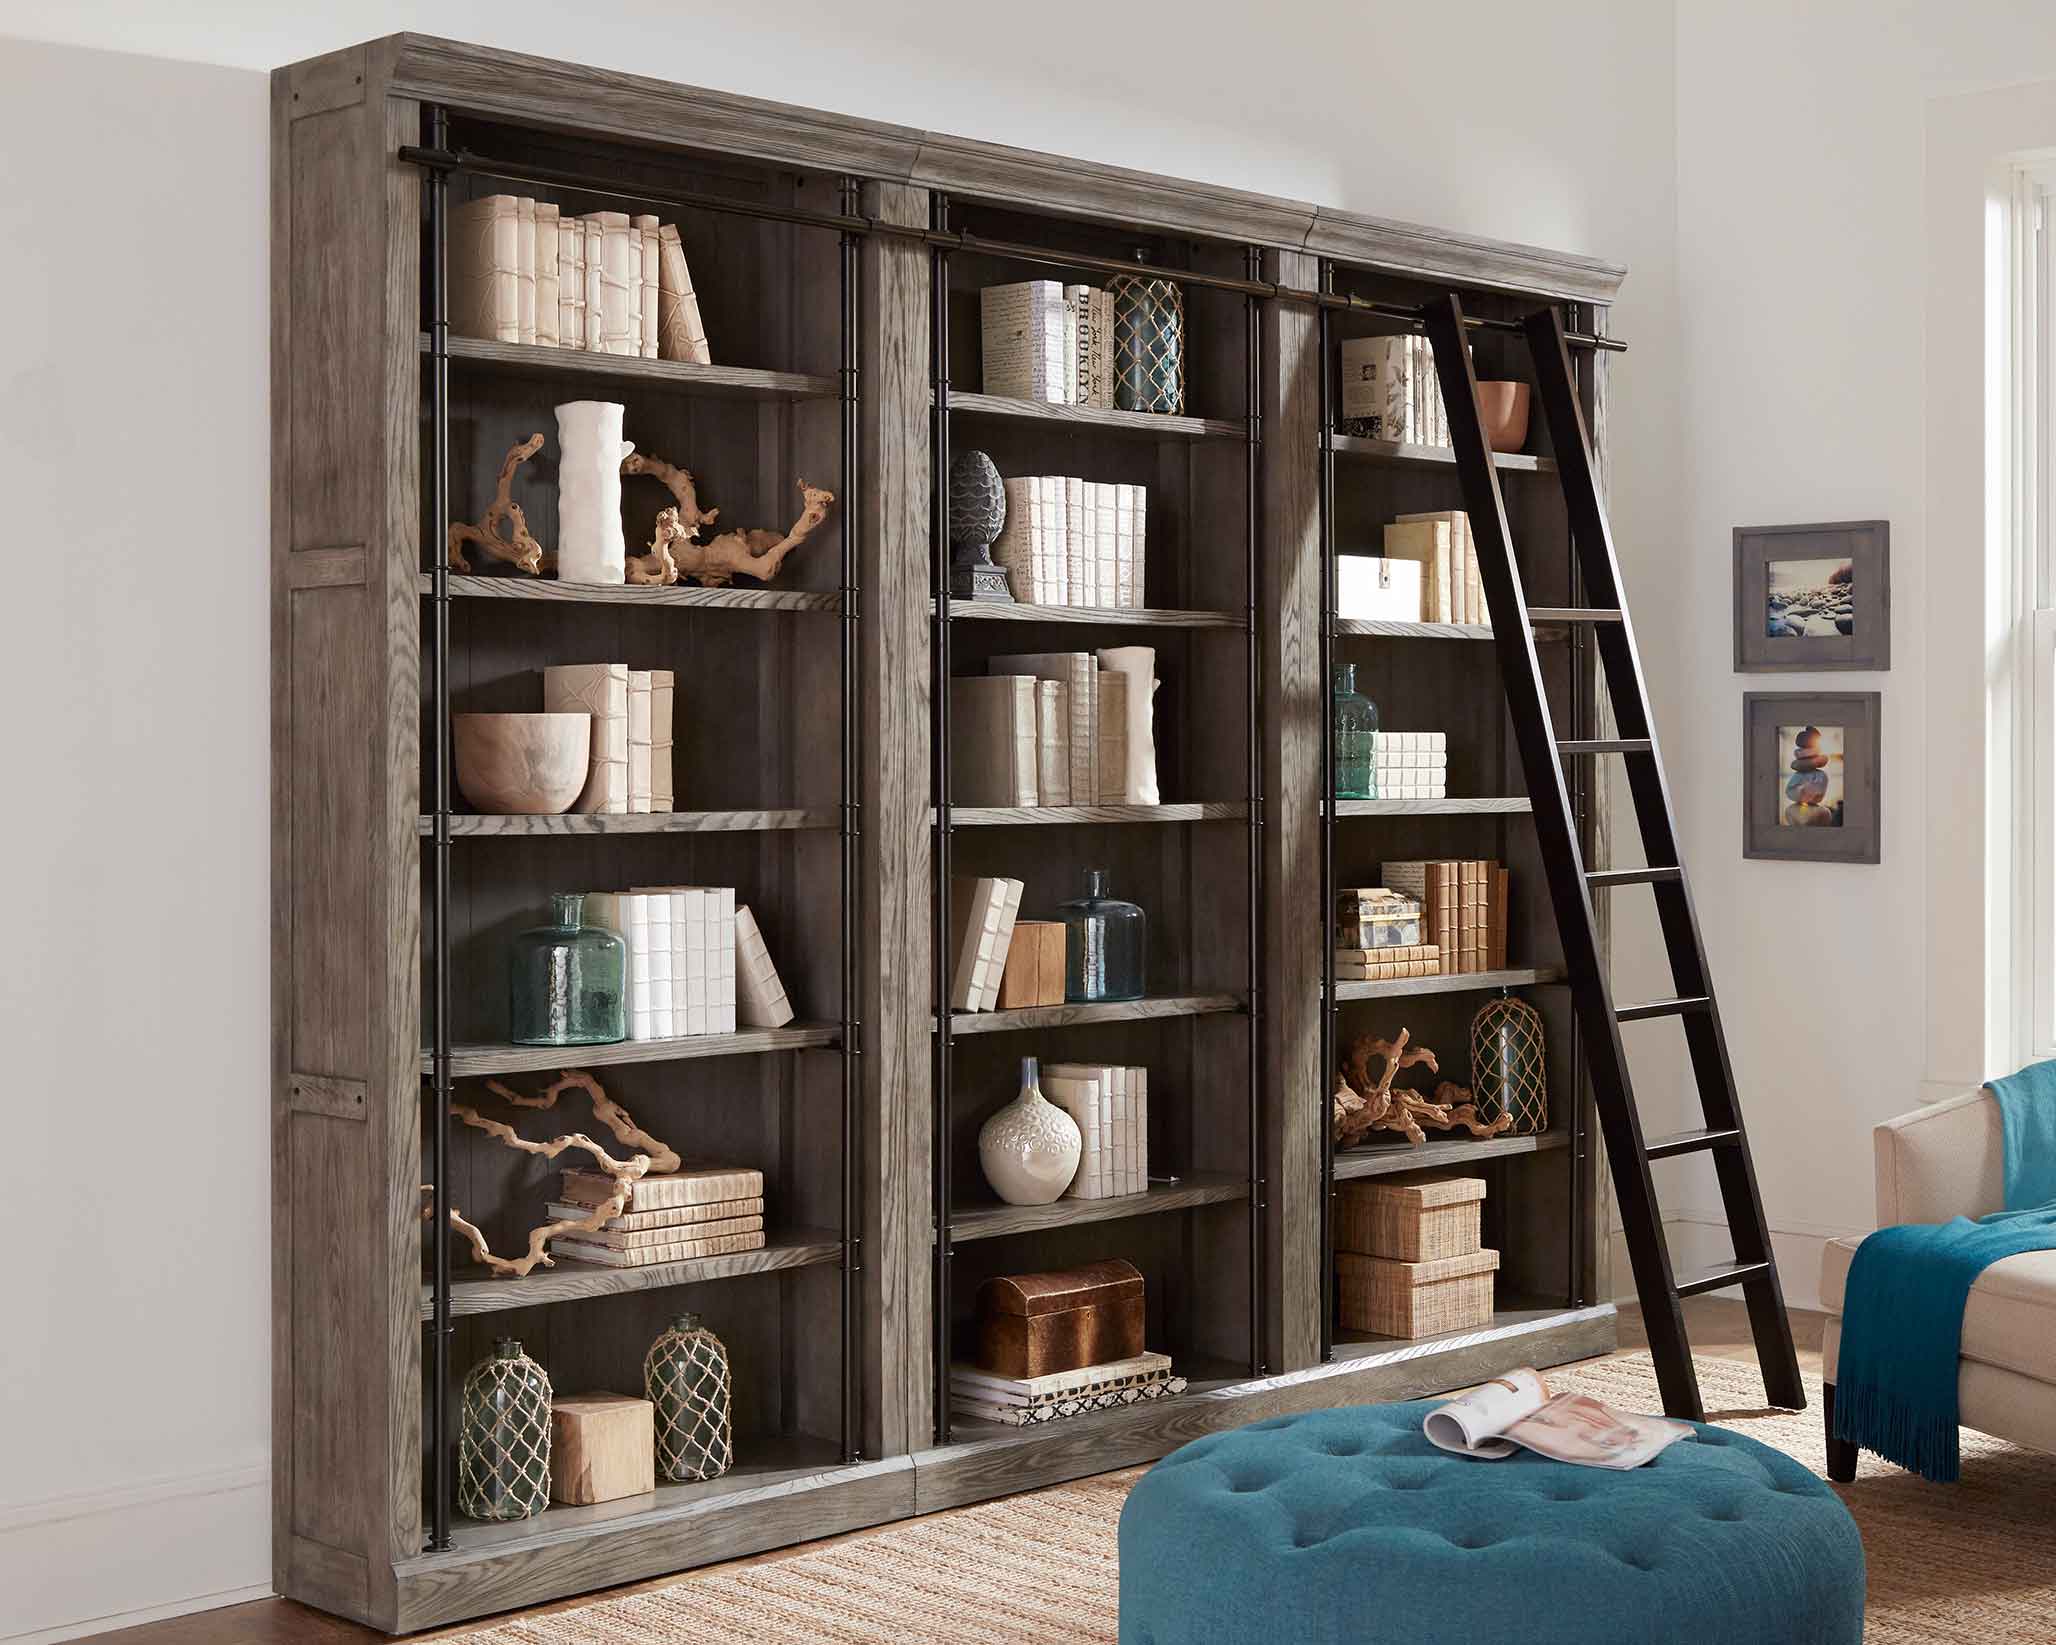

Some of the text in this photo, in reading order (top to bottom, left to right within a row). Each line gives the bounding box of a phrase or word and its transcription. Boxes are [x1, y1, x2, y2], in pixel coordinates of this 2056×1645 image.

[1091, 305, 1101, 323] New
[1091, 350, 1101, 369] New
[1091, 375, 1101, 396] York
